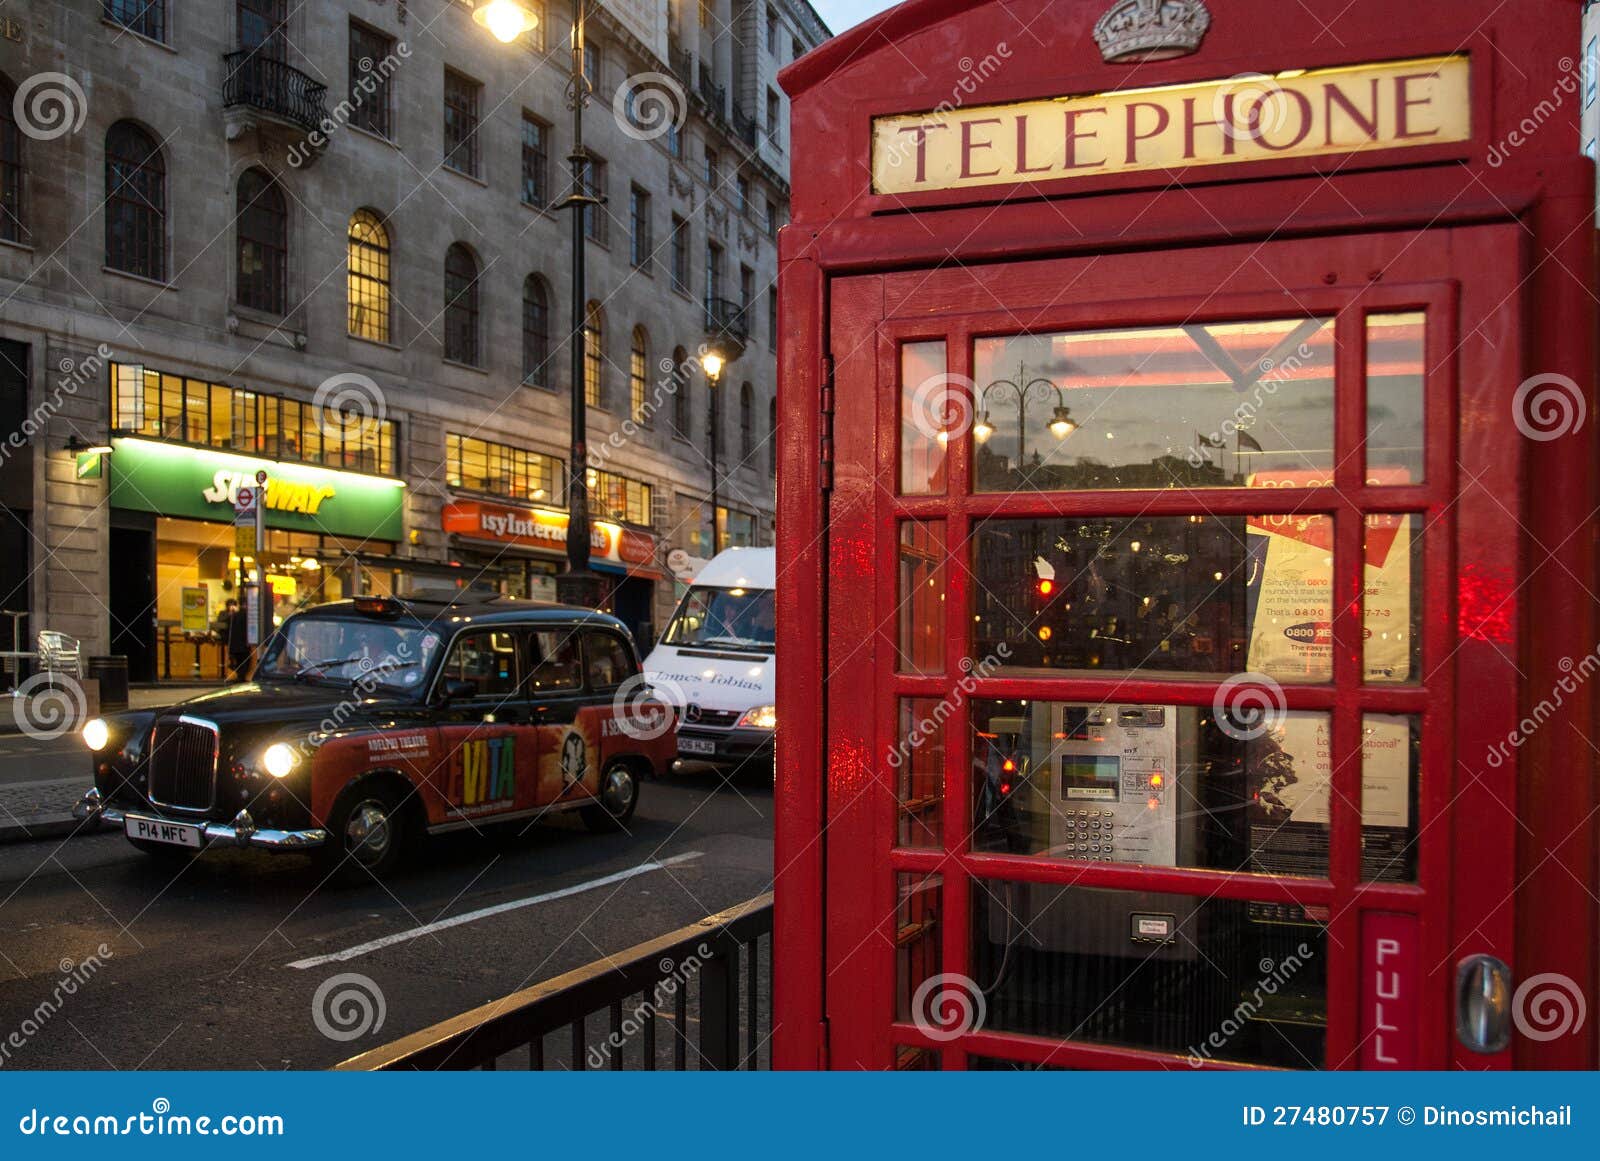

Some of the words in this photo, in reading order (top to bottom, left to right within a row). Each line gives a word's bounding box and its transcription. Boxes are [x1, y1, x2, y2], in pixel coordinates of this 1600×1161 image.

[897, 72, 1442, 184] TELEPHONE
[1286, 629, 1314, 637] 0800
[709, 673, 763, 691] Tobias
[138, 822, 158, 838] P14
[161, 826, 187, 842] MFC
[1376, 938, 1400, 1064] PULL
